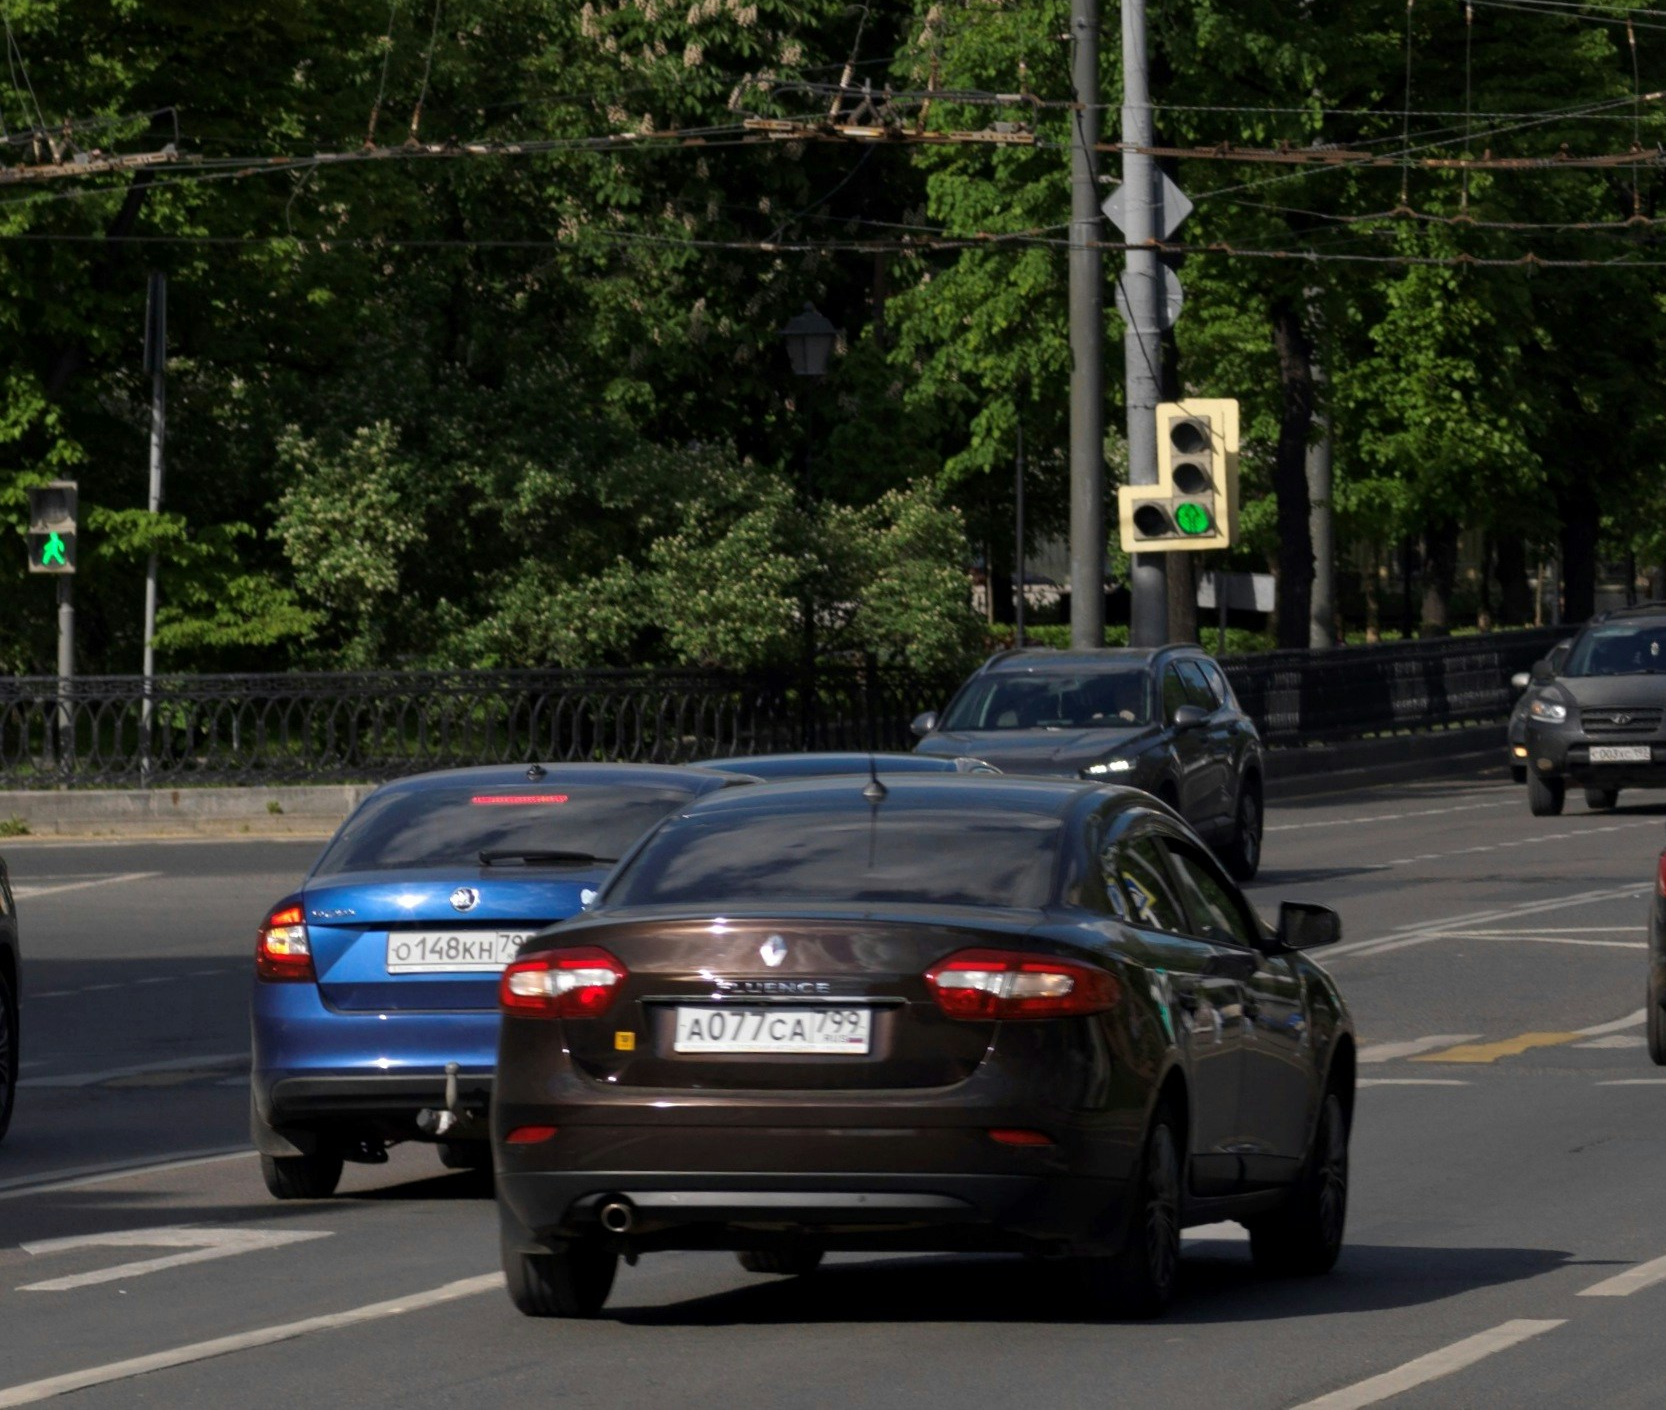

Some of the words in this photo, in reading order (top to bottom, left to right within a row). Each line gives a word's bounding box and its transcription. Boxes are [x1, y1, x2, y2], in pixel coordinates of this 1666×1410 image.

[396, 936, 493, 961] О148КН
[687, 1011, 806, 1041] А077СА
[816, 1010, 861, 1033] 799
